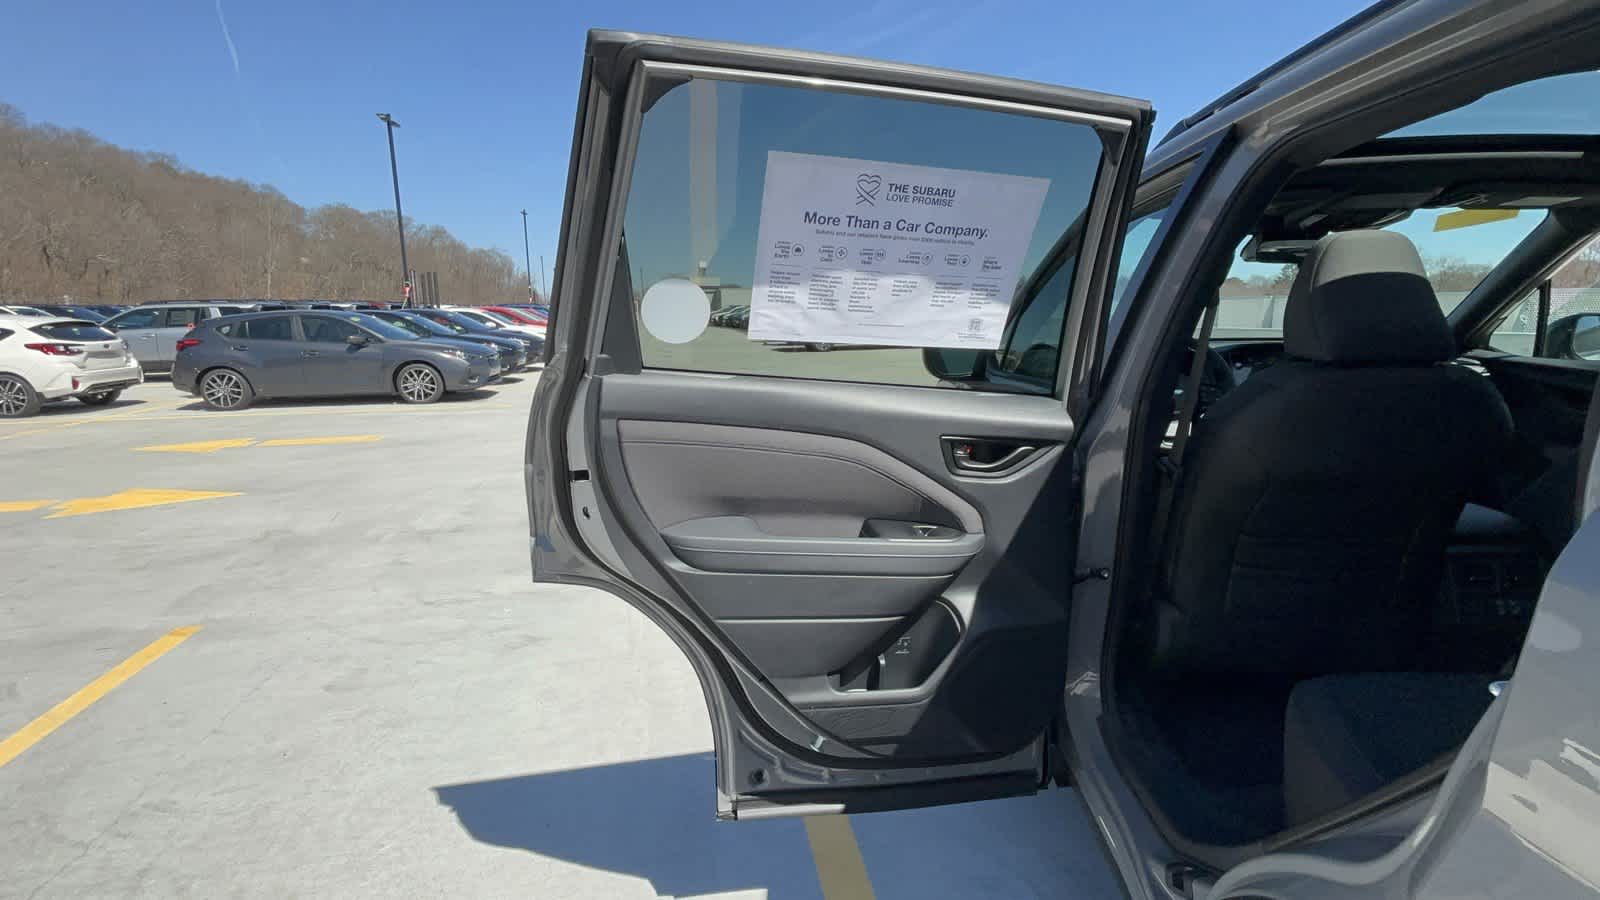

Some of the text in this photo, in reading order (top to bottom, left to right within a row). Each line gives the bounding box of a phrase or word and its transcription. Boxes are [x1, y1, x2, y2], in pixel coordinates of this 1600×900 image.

[888, 183, 956, 198] THE SUBARU
[886, 194, 954, 208] LOVE PROMISE
[803, 211, 989, 240] More Than a Car Company.
